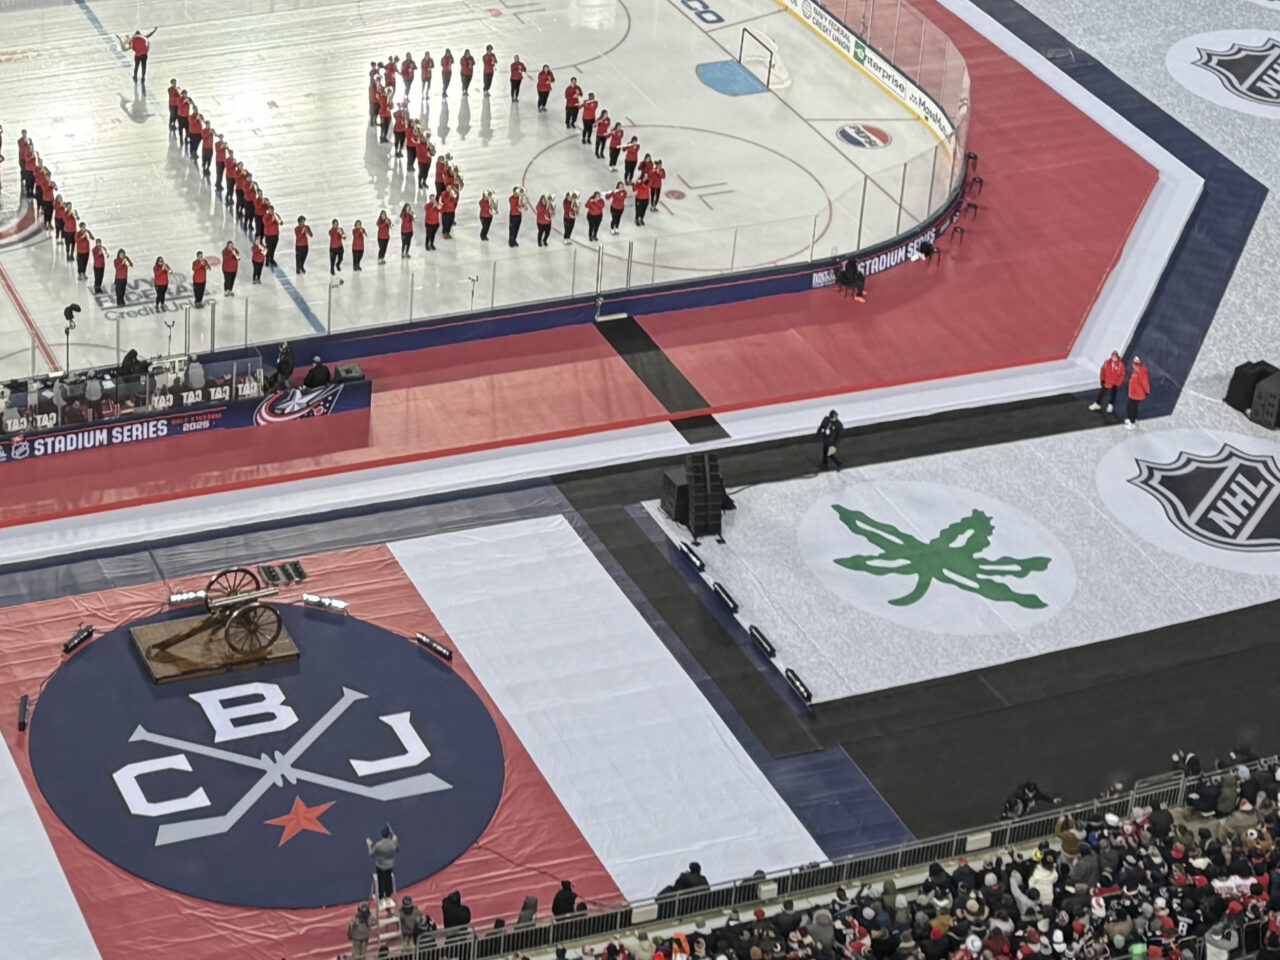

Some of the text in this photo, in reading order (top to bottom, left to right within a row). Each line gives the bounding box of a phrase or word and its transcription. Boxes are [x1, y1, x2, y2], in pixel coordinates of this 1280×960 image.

[856, 46, 906, 93] enterprise
[33, 428, 108, 456] STADIUM
[112, 420, 168, 444] SERIES
[1207, 473, 1269, 536] NHL
